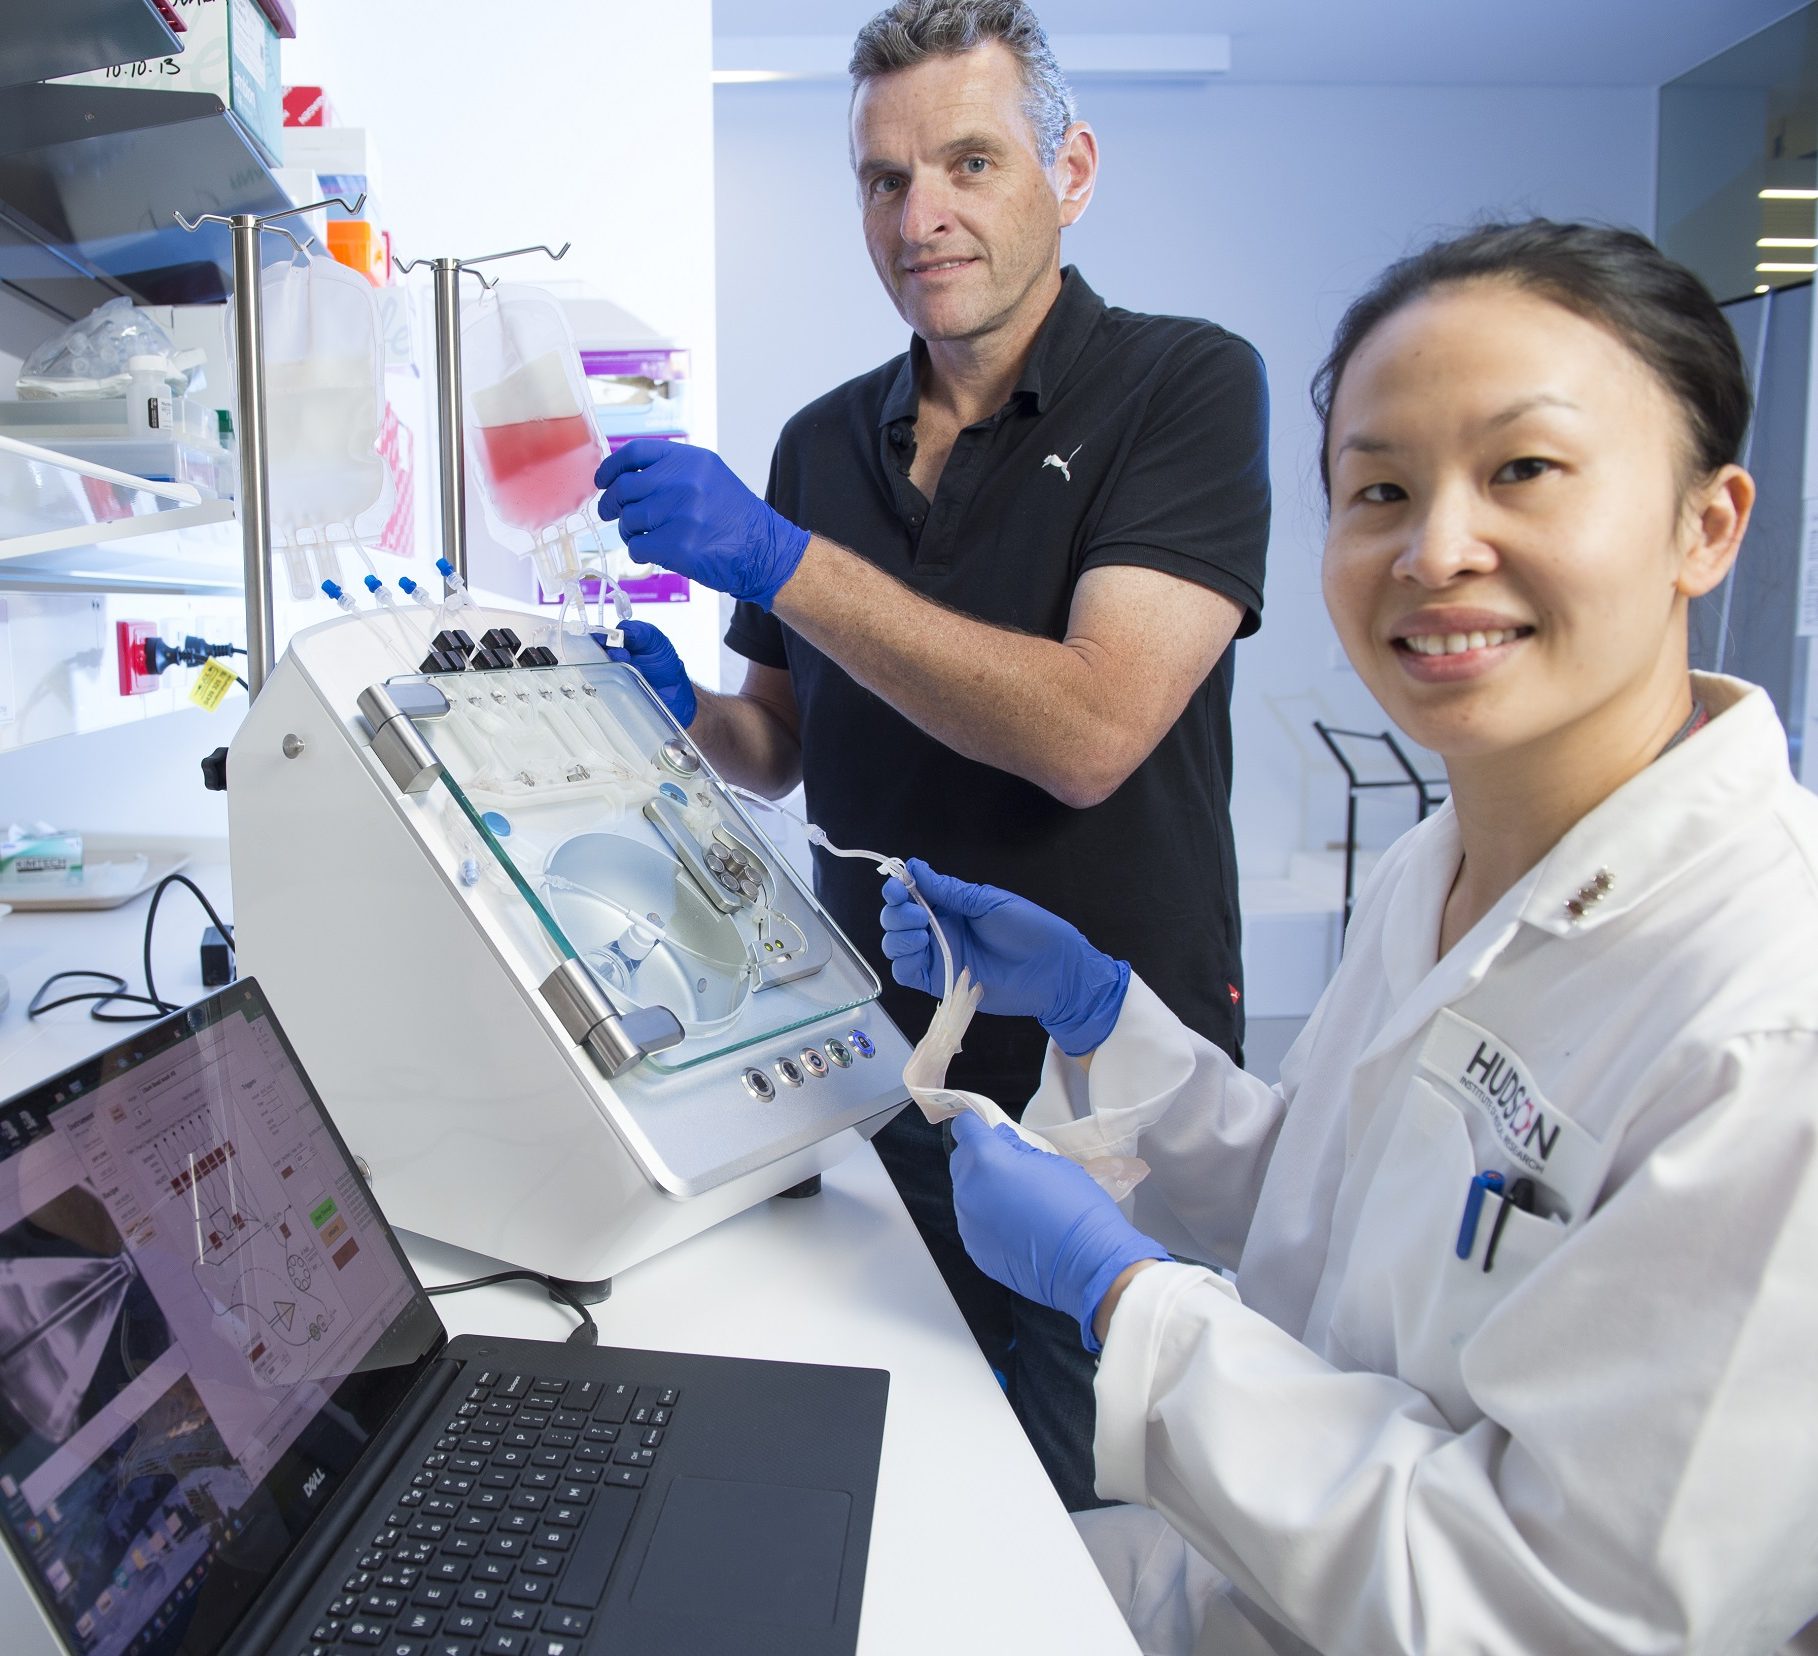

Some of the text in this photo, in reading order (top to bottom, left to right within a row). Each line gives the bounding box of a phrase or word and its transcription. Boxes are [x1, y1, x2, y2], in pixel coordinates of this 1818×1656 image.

[105, 58, 181, 78] 10.10.13
[1466, 1041, 1561, 1161] HUDSON
[303, 1468, 325, 1498] DELL
[569, 1488, 581, 1496] M
[559, 1510, 570, 1519] N
[512, 1516, 524, 1525] H
[548, 1533, 559, 1541] B
[456, 1539, 467, 1547] T
[501, 1540, 512, 1548] G
[536, 1557, 548, 1565] V
[442, 1564, 455, 1572] R
[488, 1565, 498, 1573] F
[525, 1582, 537, 1591] C
[427, 1590, 441, 1598] E
[474, 1590, 487, 1599] D
[512, 1609, 525, 1619] X
[411, 1614, 426, 1627] W
[460, 1617, 473, 1626] S
[498, 1637, 512, 1648] Z
